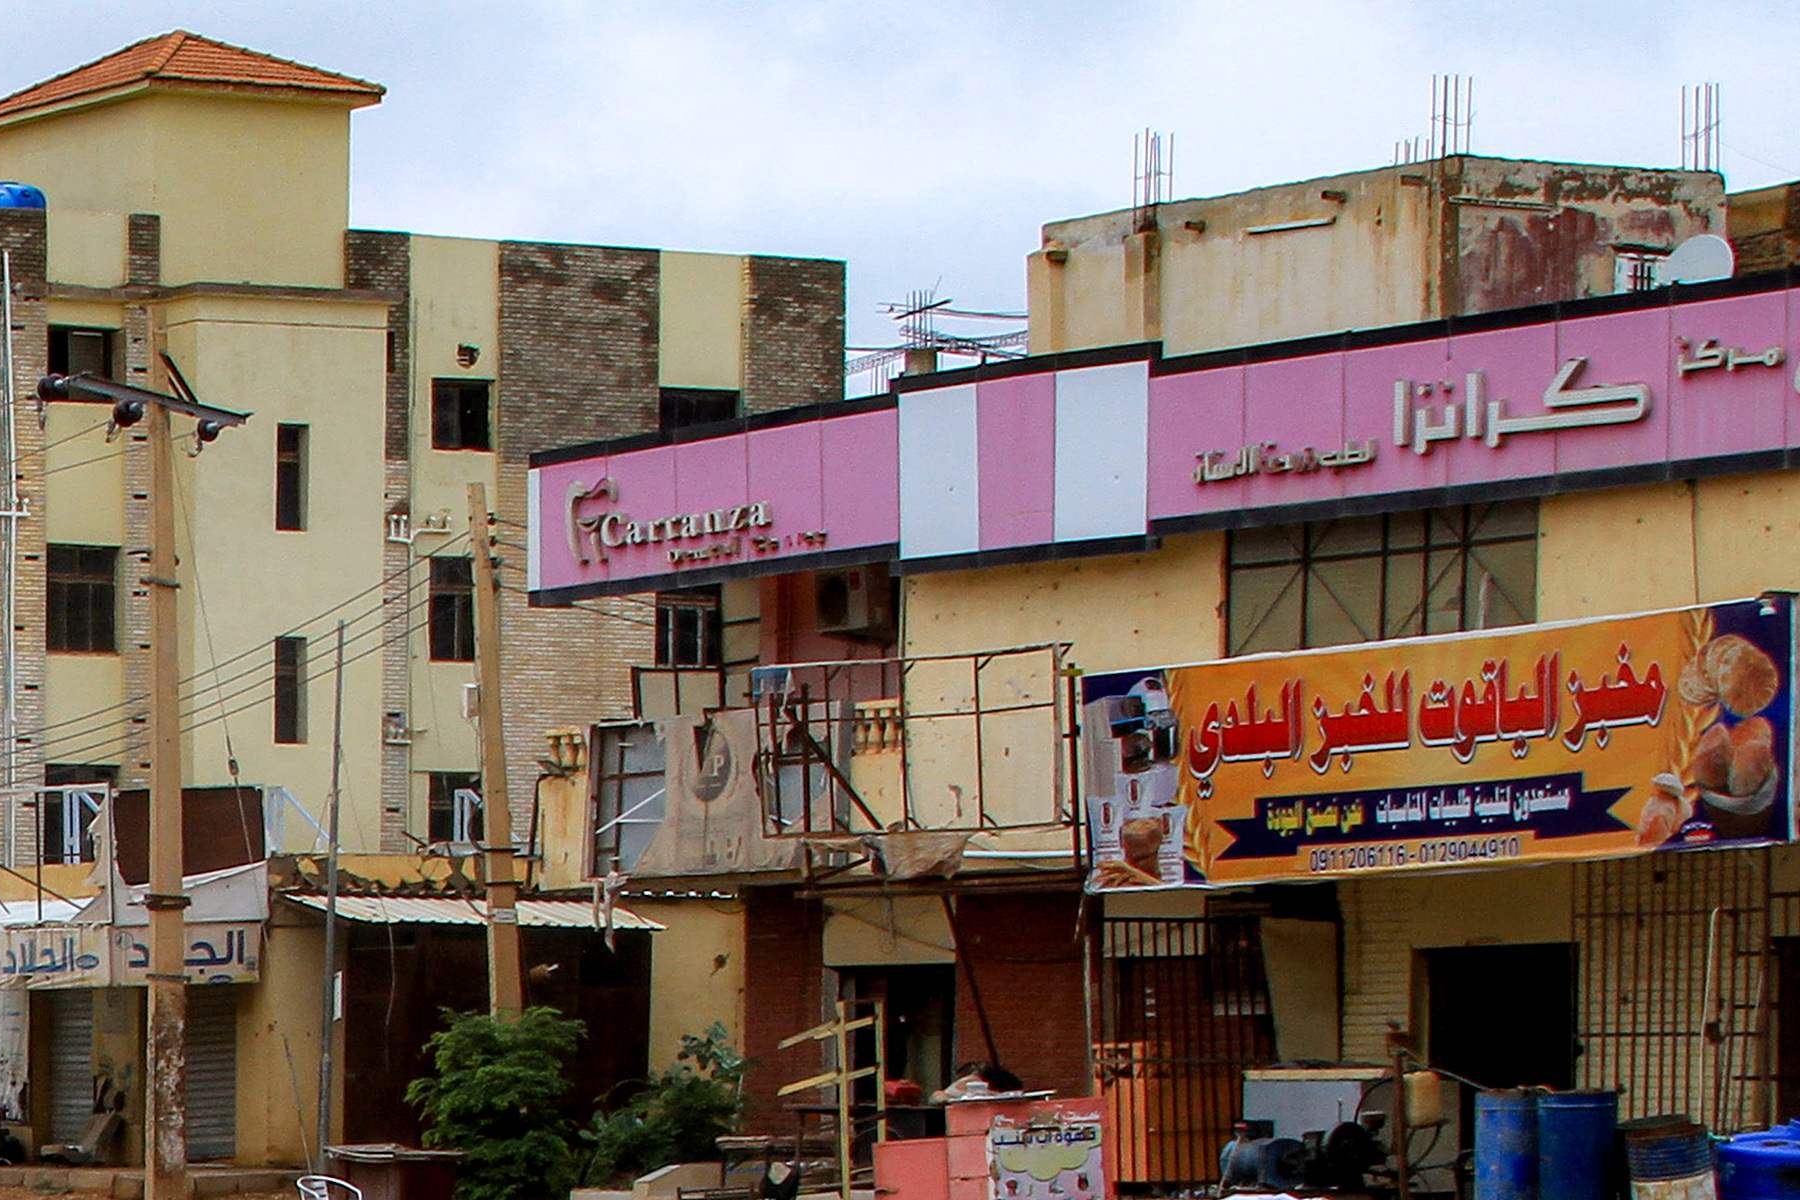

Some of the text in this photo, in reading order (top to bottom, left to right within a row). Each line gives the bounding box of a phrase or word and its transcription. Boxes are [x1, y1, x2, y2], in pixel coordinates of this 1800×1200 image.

[1676, 336, 1787, 378] مركز
[1392, 357, 1652, 455] كرانزا
[600, 500, 772, 548] Carranza
[1189, 641, 1666, 798] مخبز الياقوت للخبز البلدي
[1310, 845, 1406, 872] 0911206116
[1419, 838, 1519, 865] 0129044910
[128, 929, 245, 974] الجد
